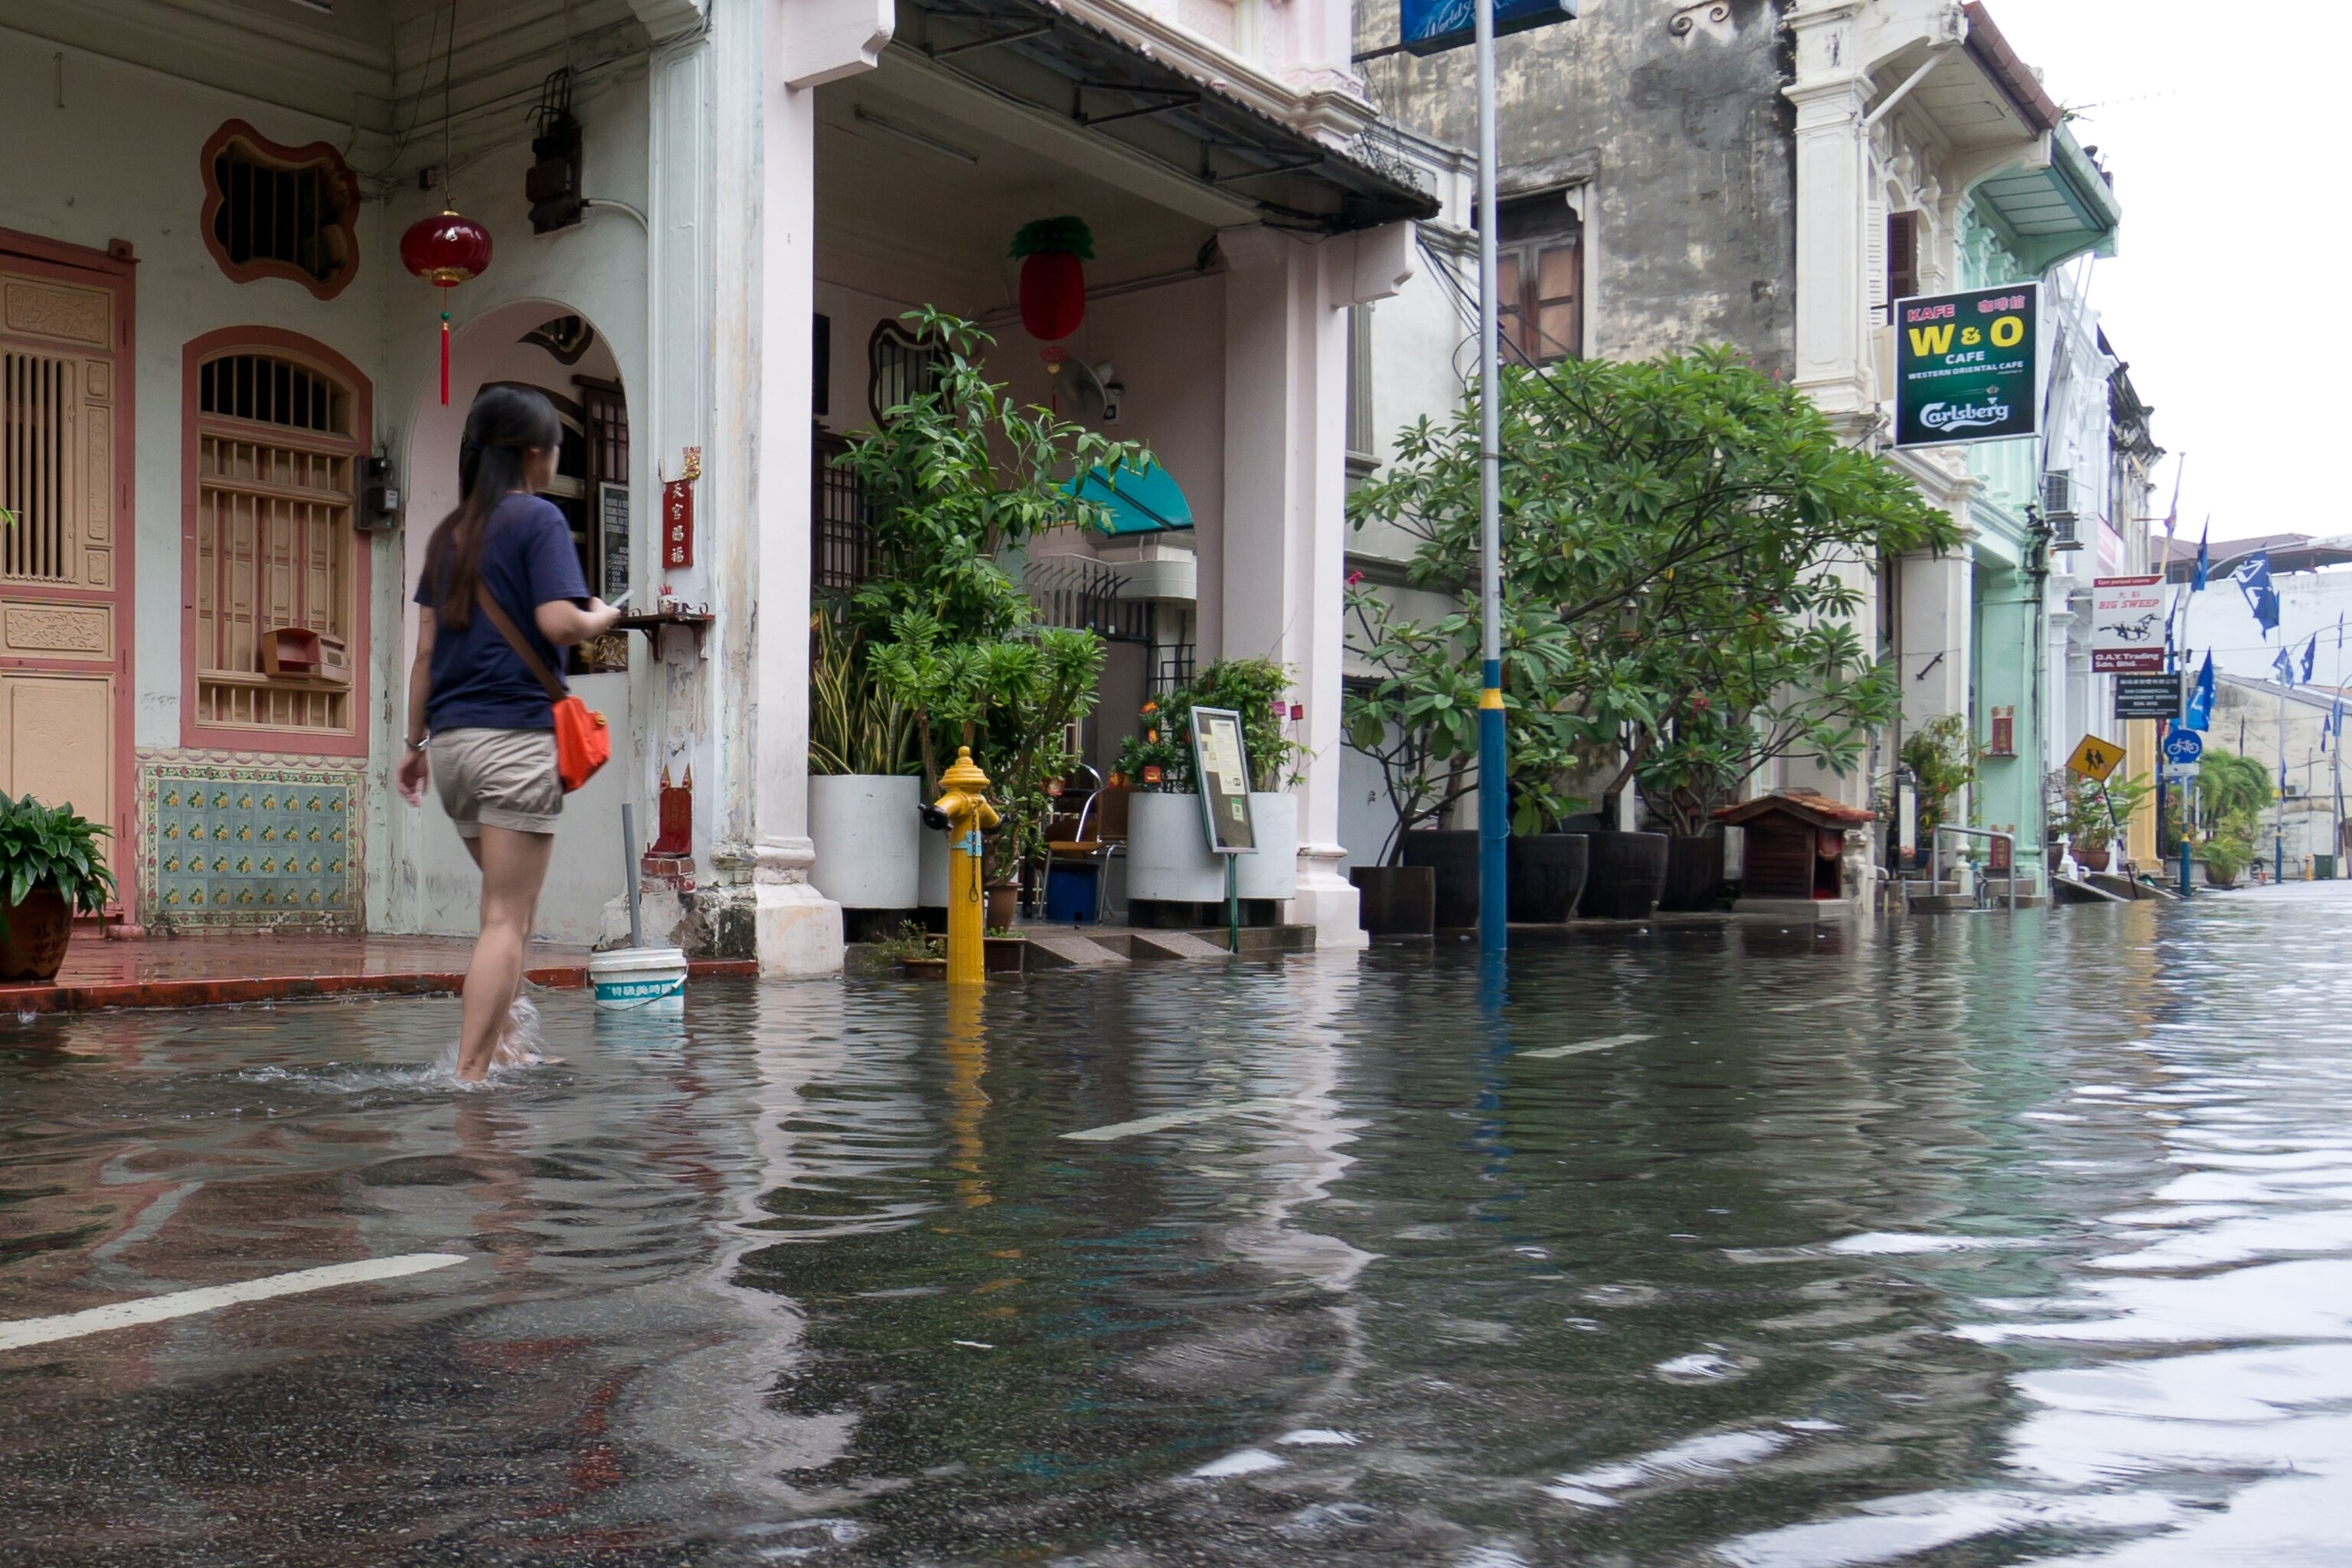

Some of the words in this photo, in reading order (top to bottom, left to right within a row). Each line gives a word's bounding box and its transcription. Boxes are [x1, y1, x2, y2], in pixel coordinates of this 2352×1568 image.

[1907, 304, 1955, 322] KAFE
[1908, 323, 1955, 357] W
[1961, 327, 1981, 345] &
[1990, 315, 2024, 348] O
[1945, 350, 1985, 365] CAFE
[1907, 368, 1952, 381] WESTERN
[1952, 364, 1998, 375] ORIENTAL
[1998, 361, 2024, 370] CAFE
[1919, 398, 2010, 431] Carlsberg
[2099, 600, 2118, 609] BIG
[2120, 598, 2160, 609] SWEEP
[2122, 652, 2160, 661] Trading
